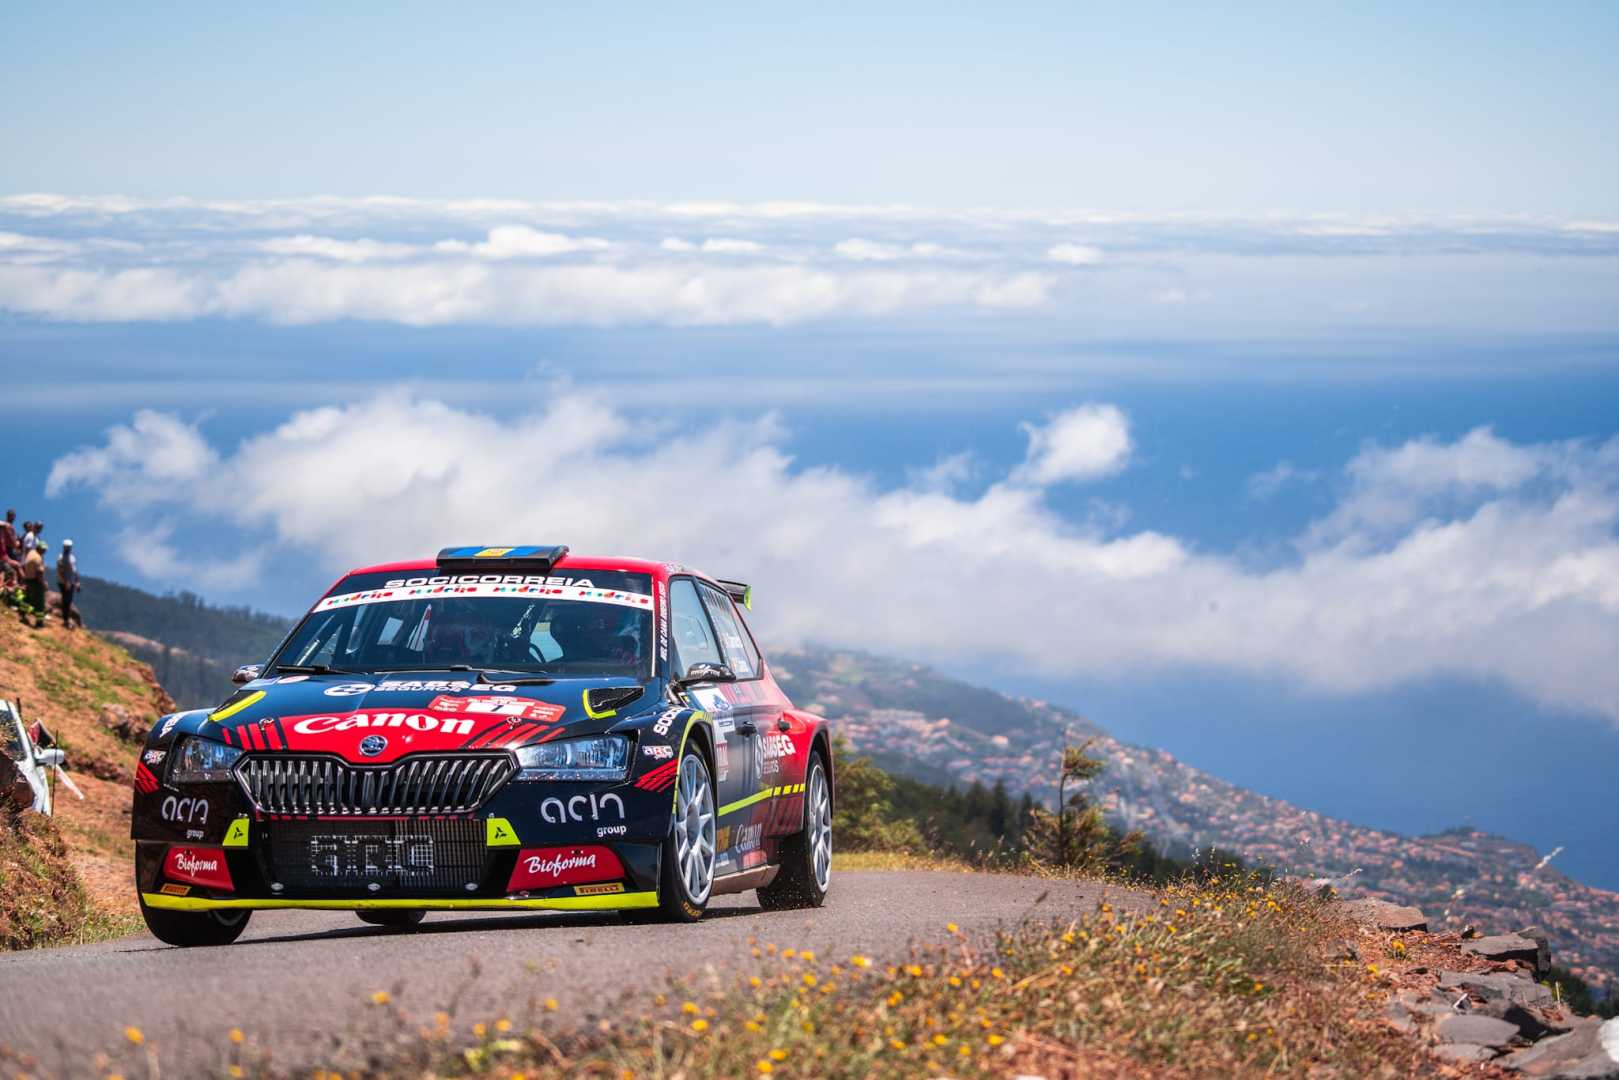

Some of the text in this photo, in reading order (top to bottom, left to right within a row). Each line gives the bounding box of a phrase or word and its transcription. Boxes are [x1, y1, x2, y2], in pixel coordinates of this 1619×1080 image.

[384, 575, 595, 588] SOCICORREIA
[293, 712, 476, 735] Canon
[541, 793, 625, 823] acin
[186, 829, 205, 839] group
[597, 825, 627, 837] group
[175, 853, 218, 877] Bioforma
[523, 854, 596, 877] Bioforma
